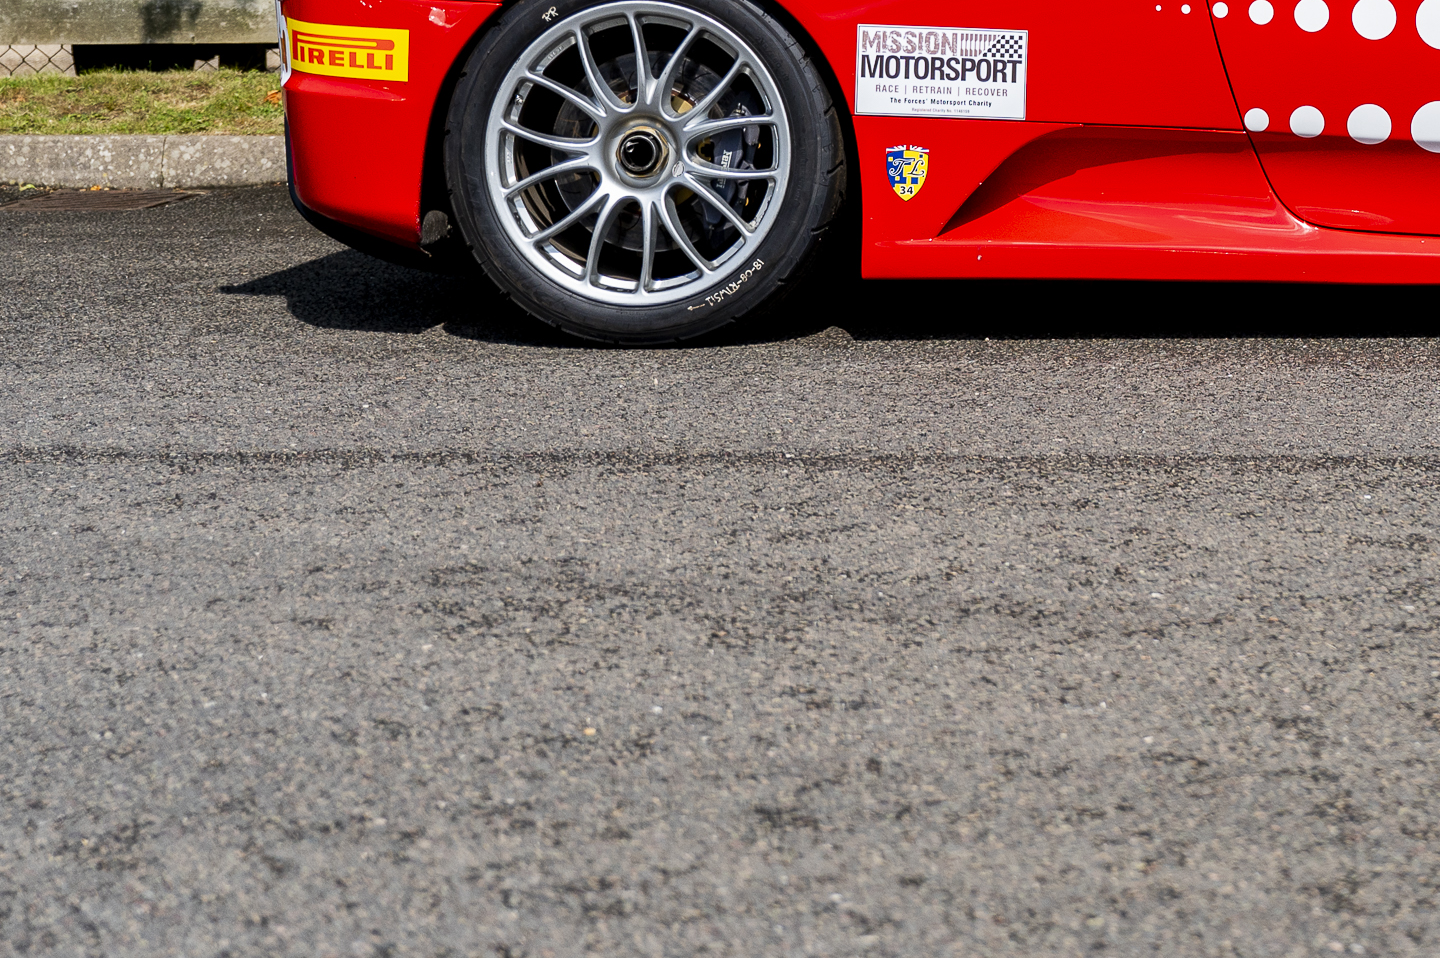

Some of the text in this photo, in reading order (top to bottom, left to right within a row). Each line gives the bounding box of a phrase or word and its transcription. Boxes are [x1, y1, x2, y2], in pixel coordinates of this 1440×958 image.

[291, 29, 395, 71] PIRELLI
[861, 29, 958, 56] MISSION
[860, 54, 1023, 84] MOTORSPORT
[875, 84, 1008, 97] RACE RETRAIN RECOVER
[930, 99, 967, 108] Motorsport
[968, 100, 992, 108] Charity
[900, 185, 914, 195] 34
